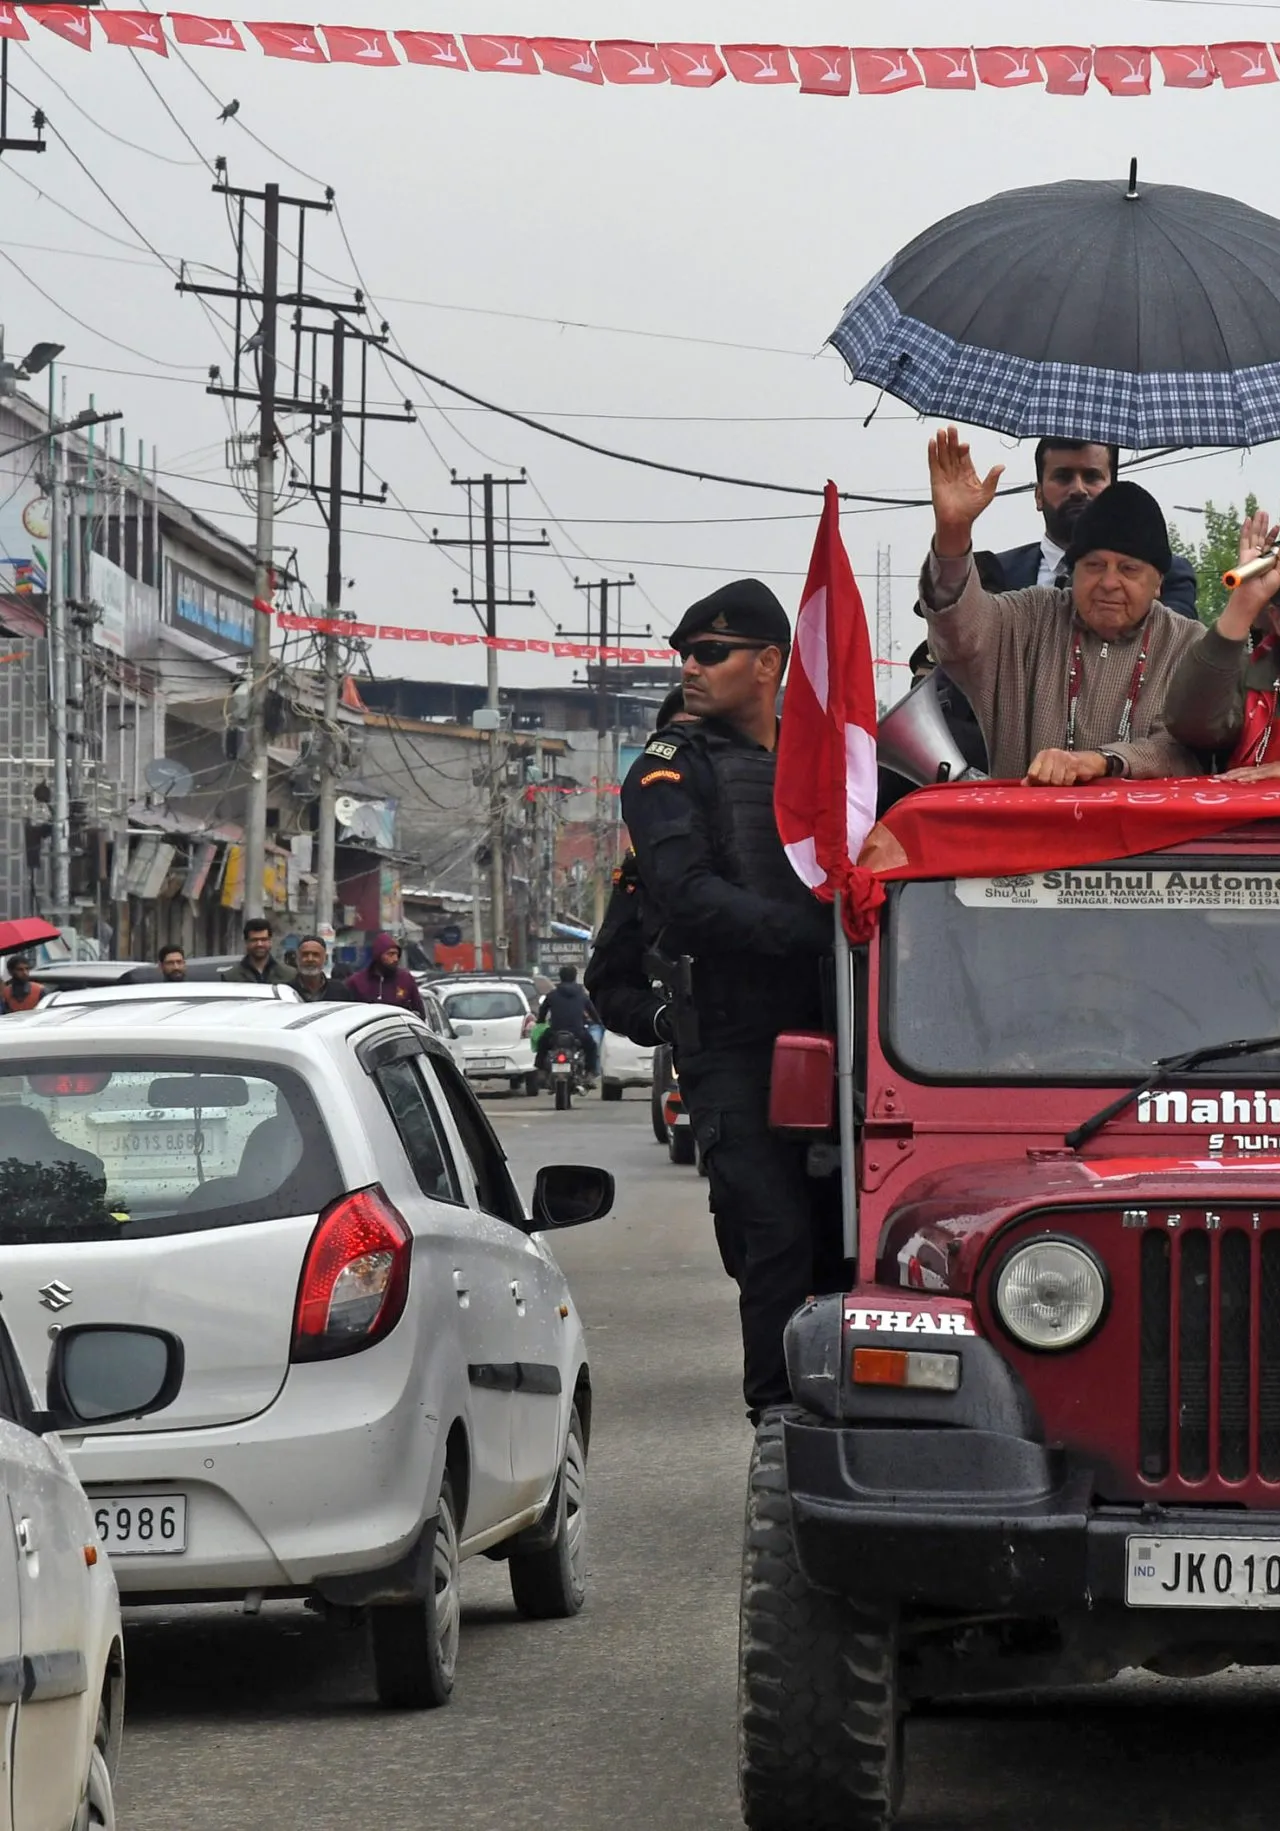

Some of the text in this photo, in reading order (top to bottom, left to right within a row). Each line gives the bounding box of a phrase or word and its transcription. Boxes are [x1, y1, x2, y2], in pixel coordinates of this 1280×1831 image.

[641, 770, 681, 785] COMMANDO
[1042, 871, 1153, 890] Shuhul
[1109, 889, 1164, 897] NARWAL
[1167, 889, 1221, 898] BY-PASS
[1224, 890, 1245, 898] PH:
[1113, 897, 1164, 905] NOWGAM
[1167, 897, 1221, 905] BY-PASS
[1224, 897, 1245, 905] PH:
[845, 1309, 975, 1336] THAR
[1133, 1565, 1156, 1578] IND
